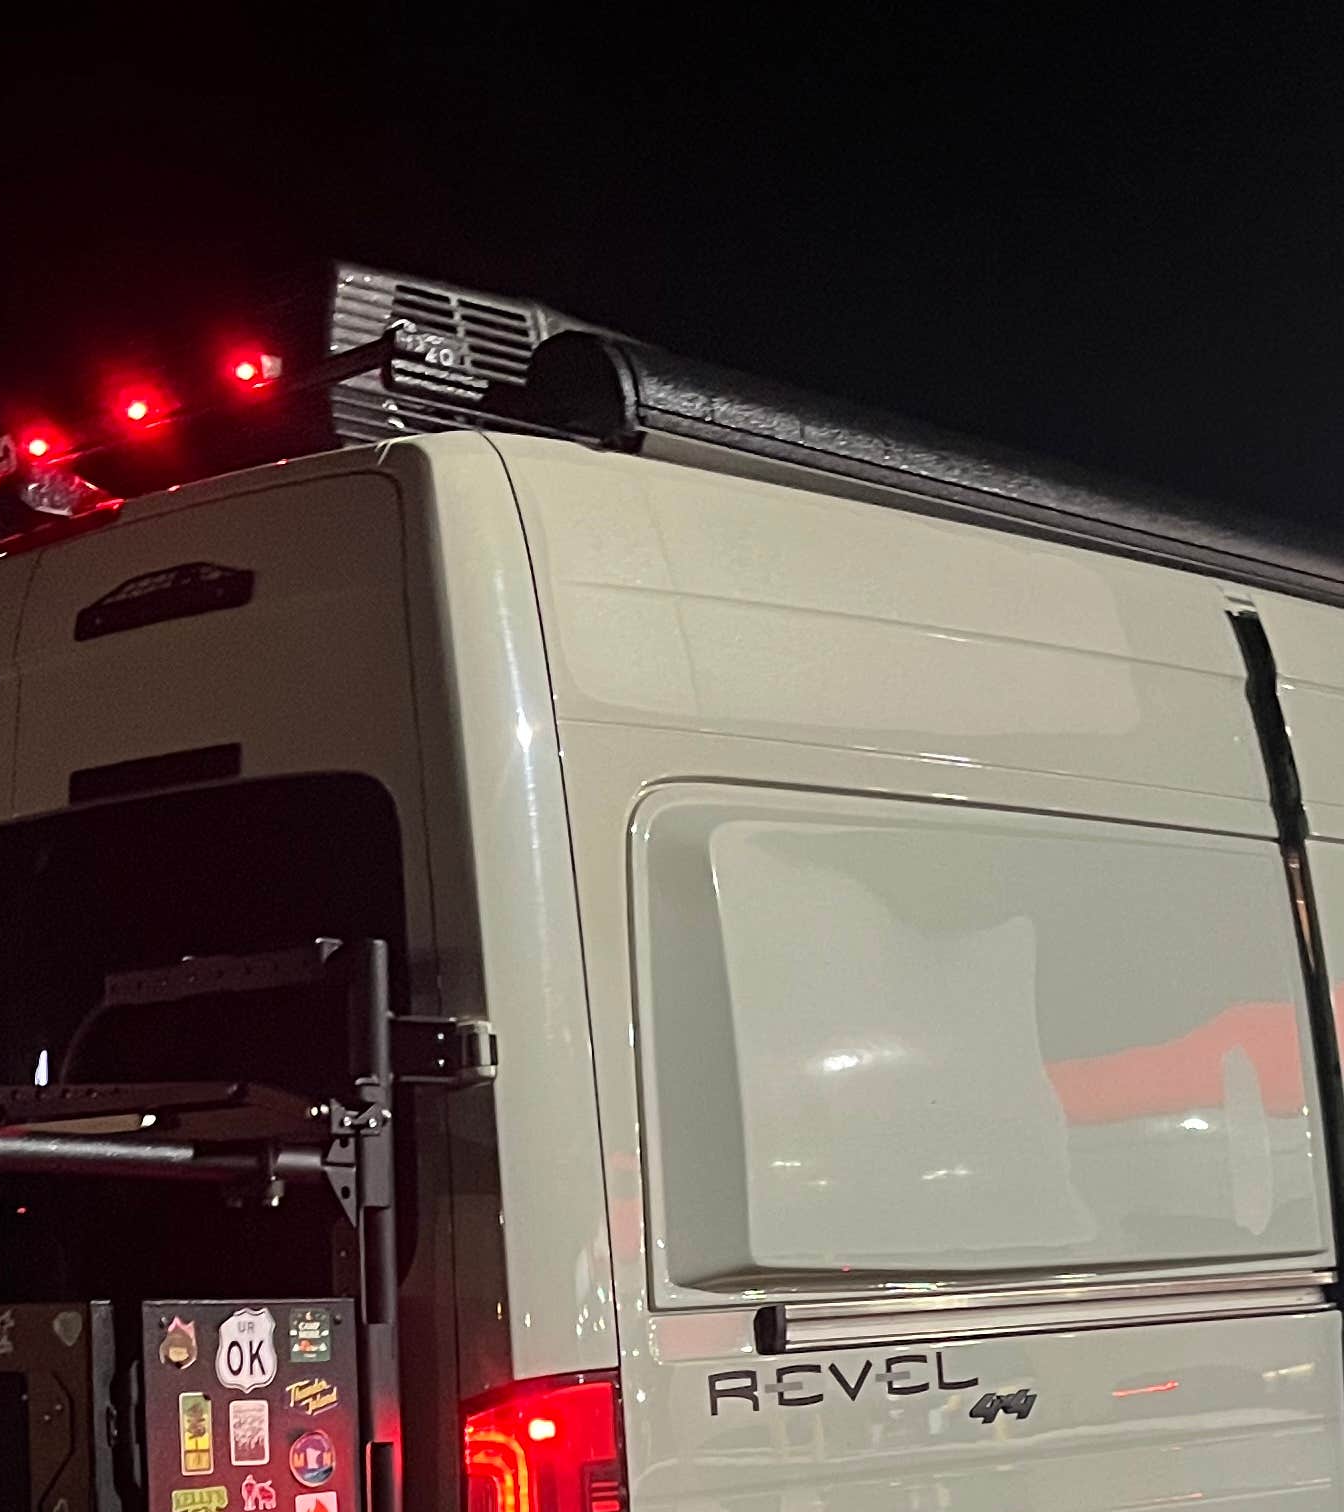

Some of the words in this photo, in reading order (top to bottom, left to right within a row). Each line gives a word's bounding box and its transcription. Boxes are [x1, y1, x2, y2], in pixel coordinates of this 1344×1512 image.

[238, 1321, 255, 1334] UR
[227, 1340, 266, 1376] OK
[708, 1351, 979, 1416] REVEL
